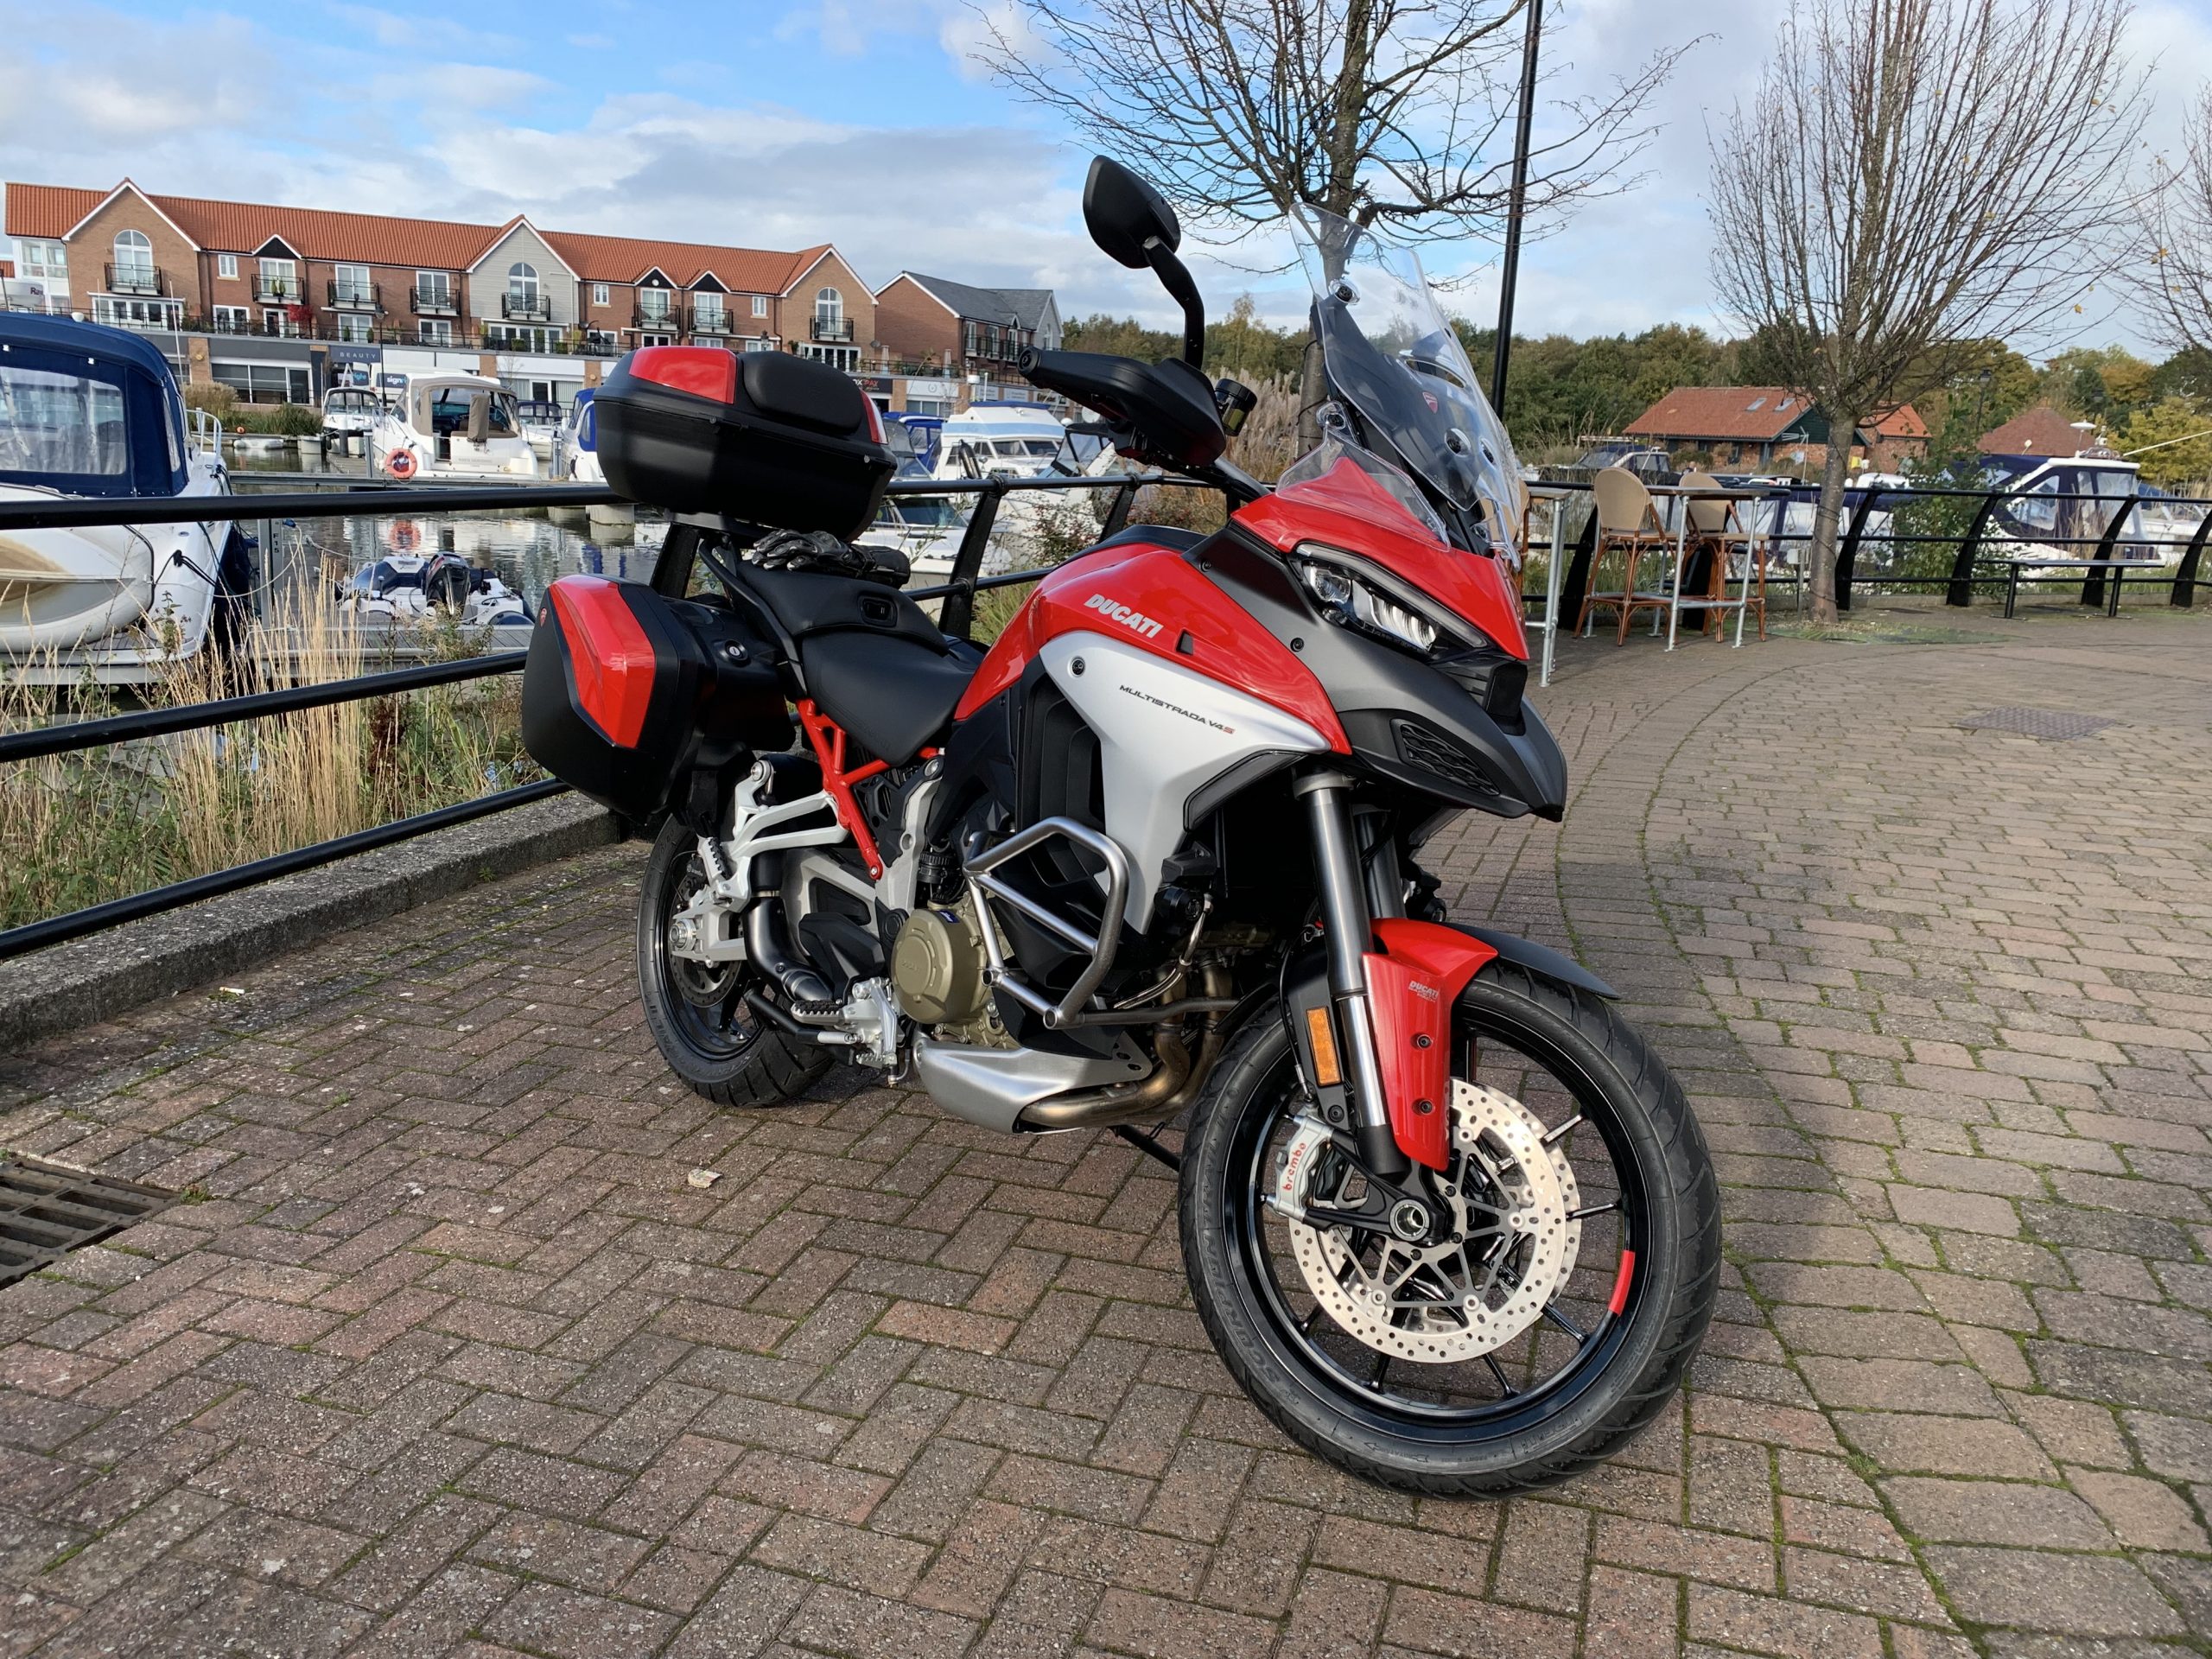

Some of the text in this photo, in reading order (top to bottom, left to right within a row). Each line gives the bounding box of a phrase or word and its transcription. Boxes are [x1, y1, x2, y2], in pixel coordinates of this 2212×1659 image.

[1084, 594, 1165, 639] DUCATI
[1119, 684, 1236, 734] MULTISTRADA V4S
[1409, 980, 1440, 999] DUCATI
[1281, 1141, 1307, 1192] brembo
